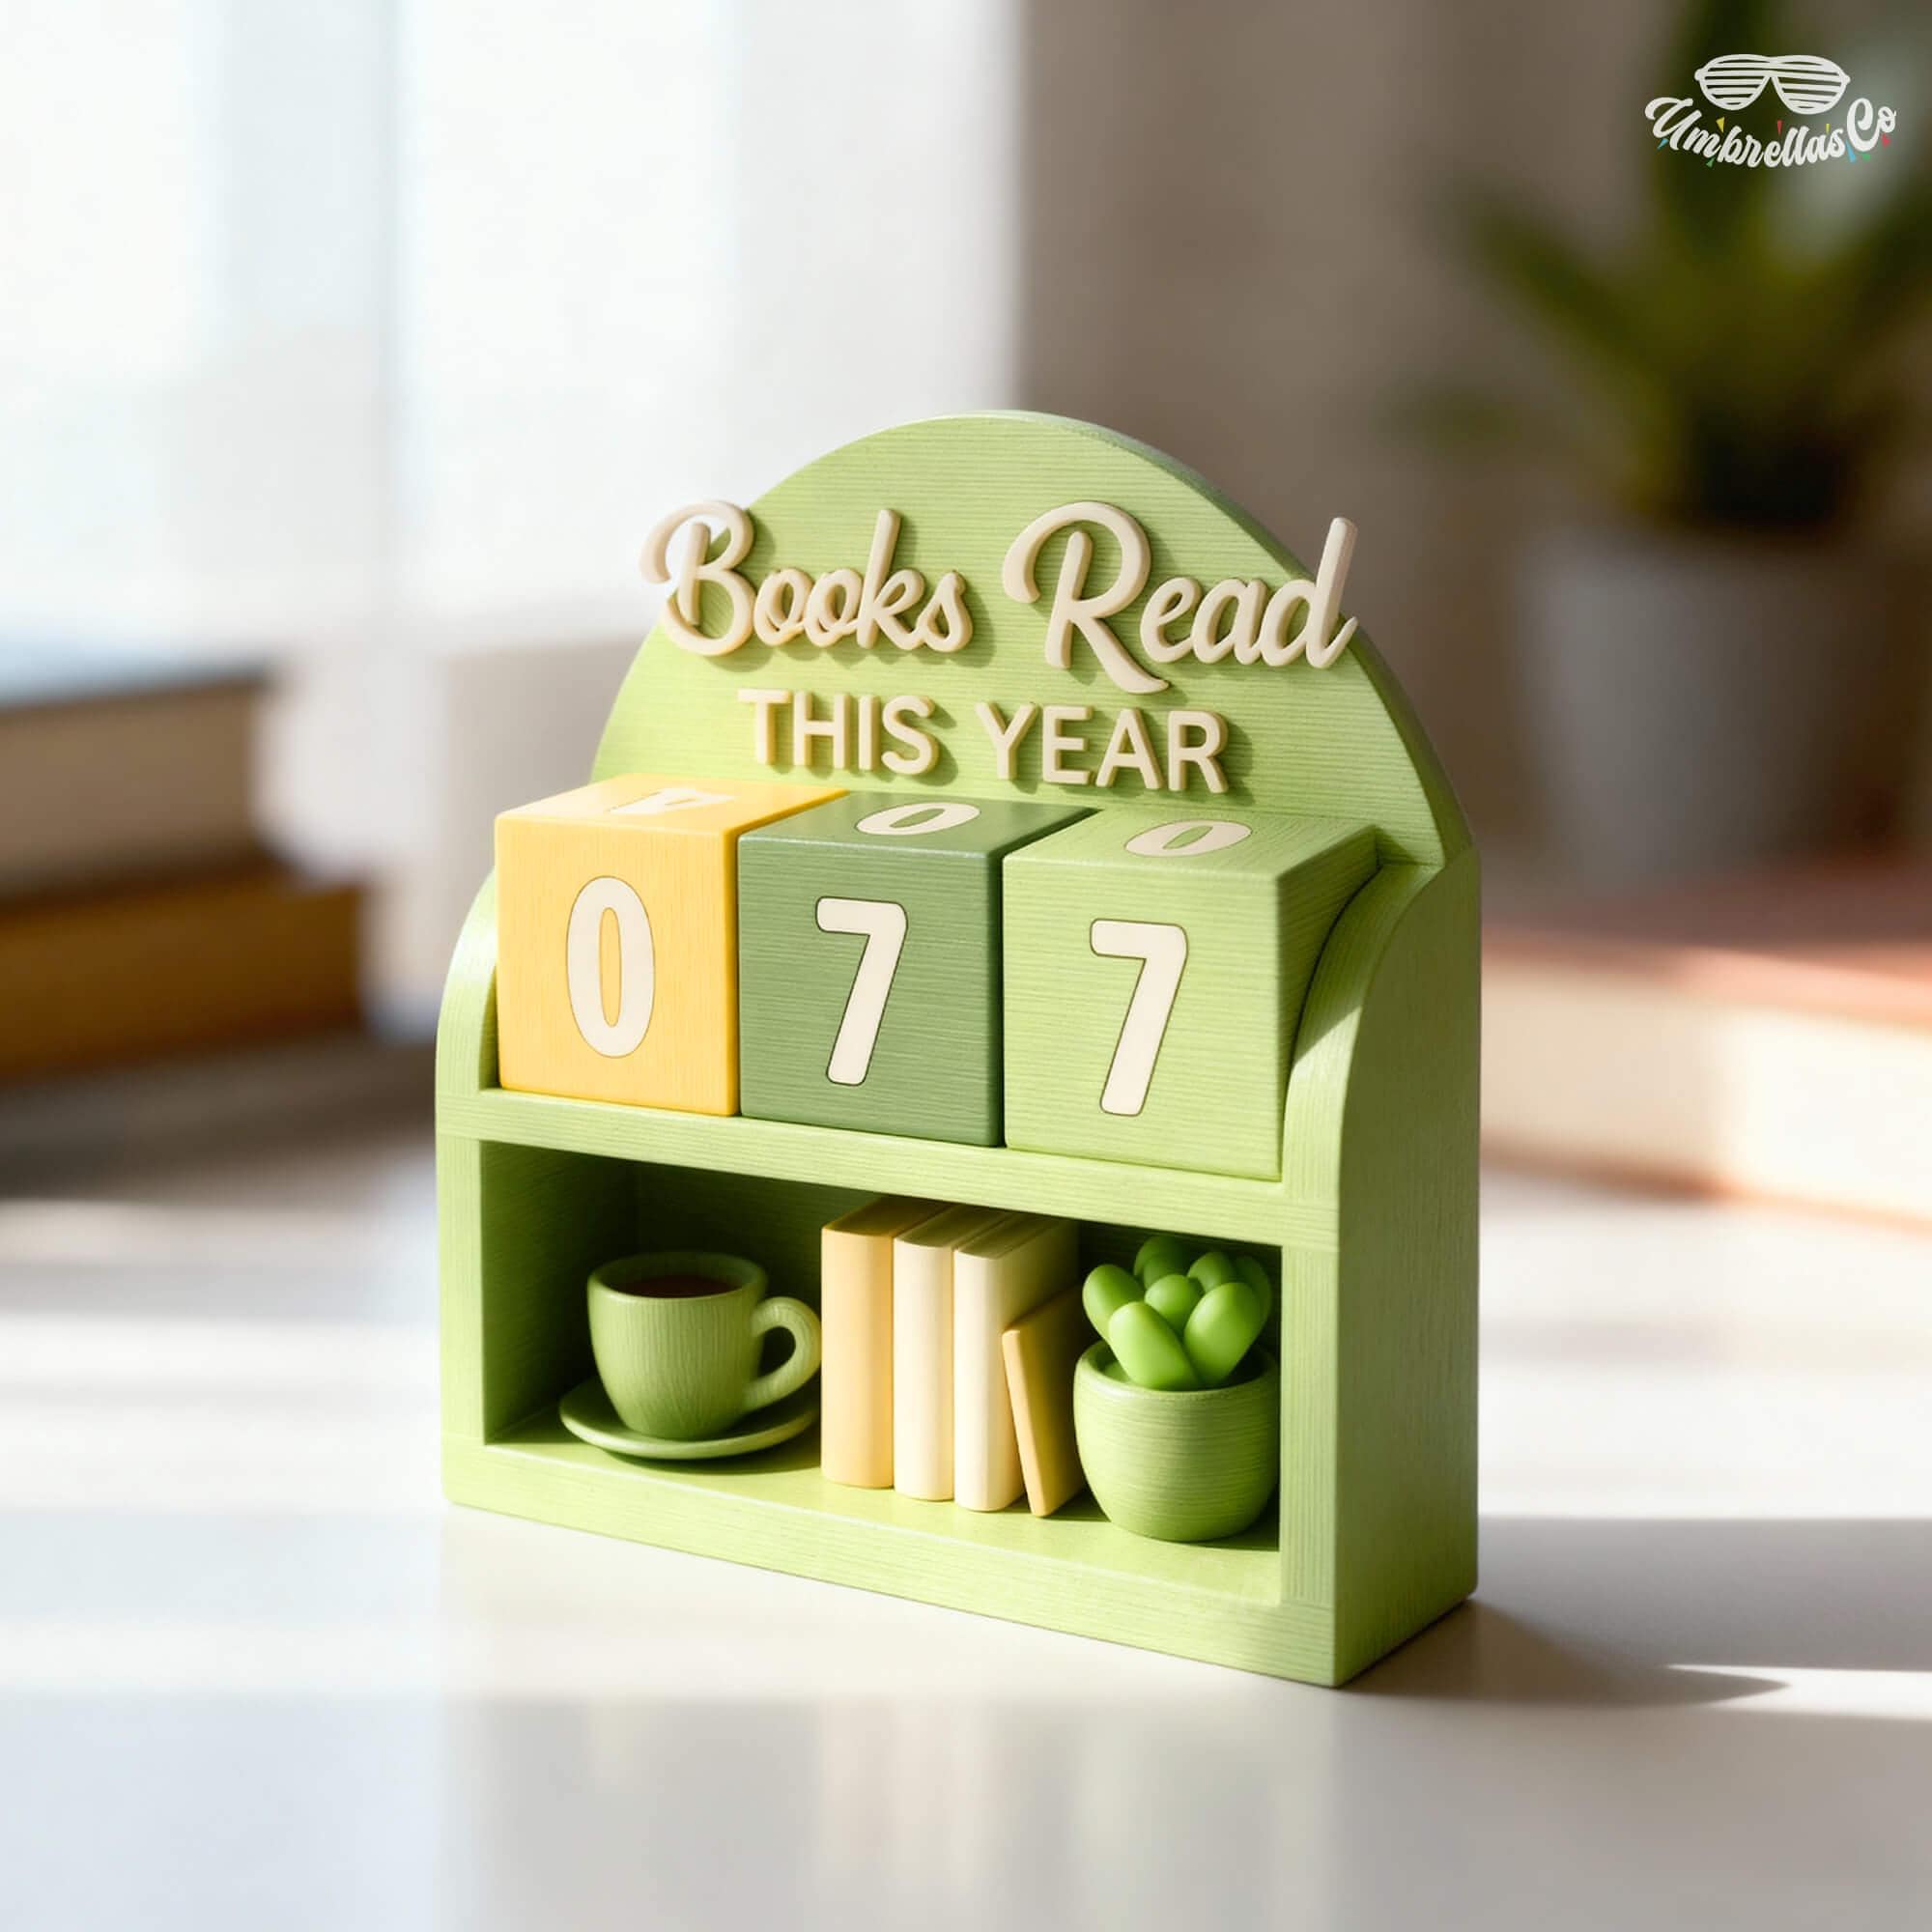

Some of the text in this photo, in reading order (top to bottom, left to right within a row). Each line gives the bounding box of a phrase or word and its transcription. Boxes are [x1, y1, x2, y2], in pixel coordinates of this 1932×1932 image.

[639, 498, 1359, 696] Books Read
[736, 687, 1230, 795] THIS YEAR
[565, 874, 1189, 1118] 0 7 7
